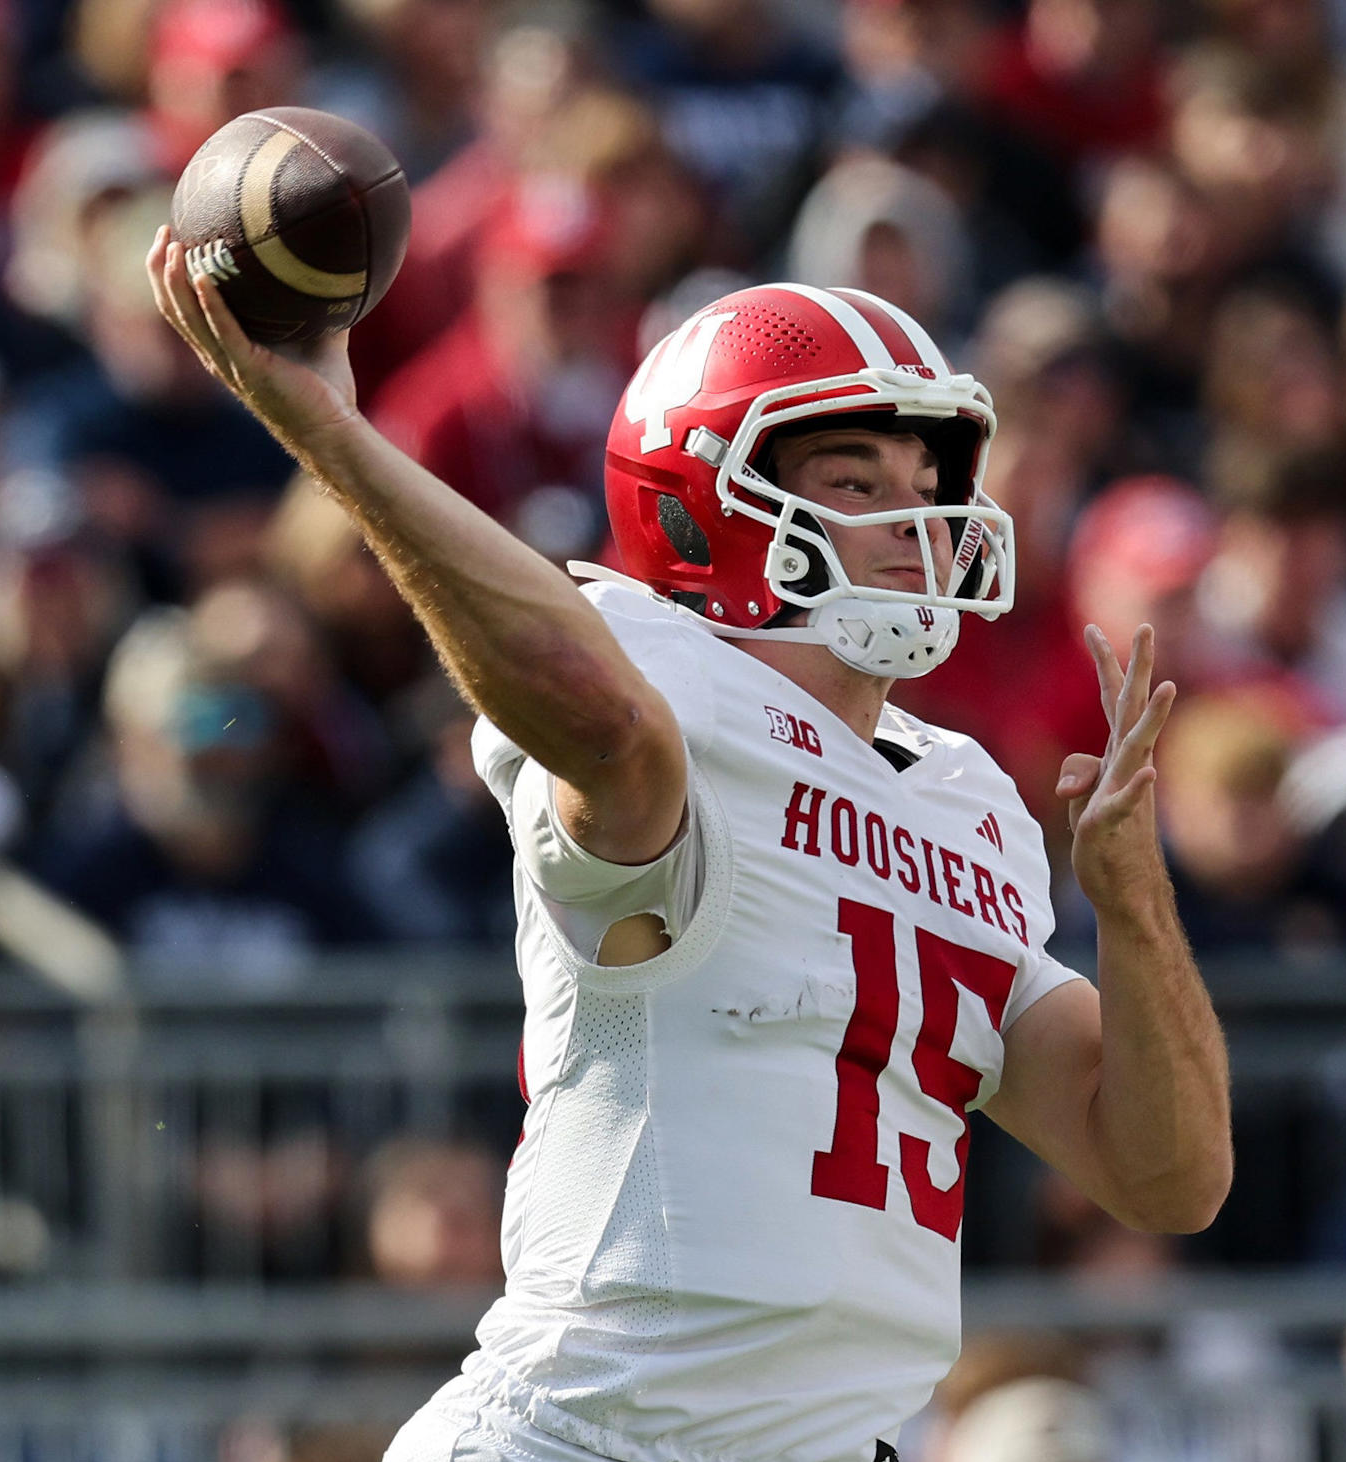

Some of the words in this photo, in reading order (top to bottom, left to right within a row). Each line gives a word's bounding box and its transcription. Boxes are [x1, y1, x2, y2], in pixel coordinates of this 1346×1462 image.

[956, 519, 983, 571] INDIANA
[781, 781, 1030, 947] HOOSIERS
[811, 896, 1017, 1243] 15
